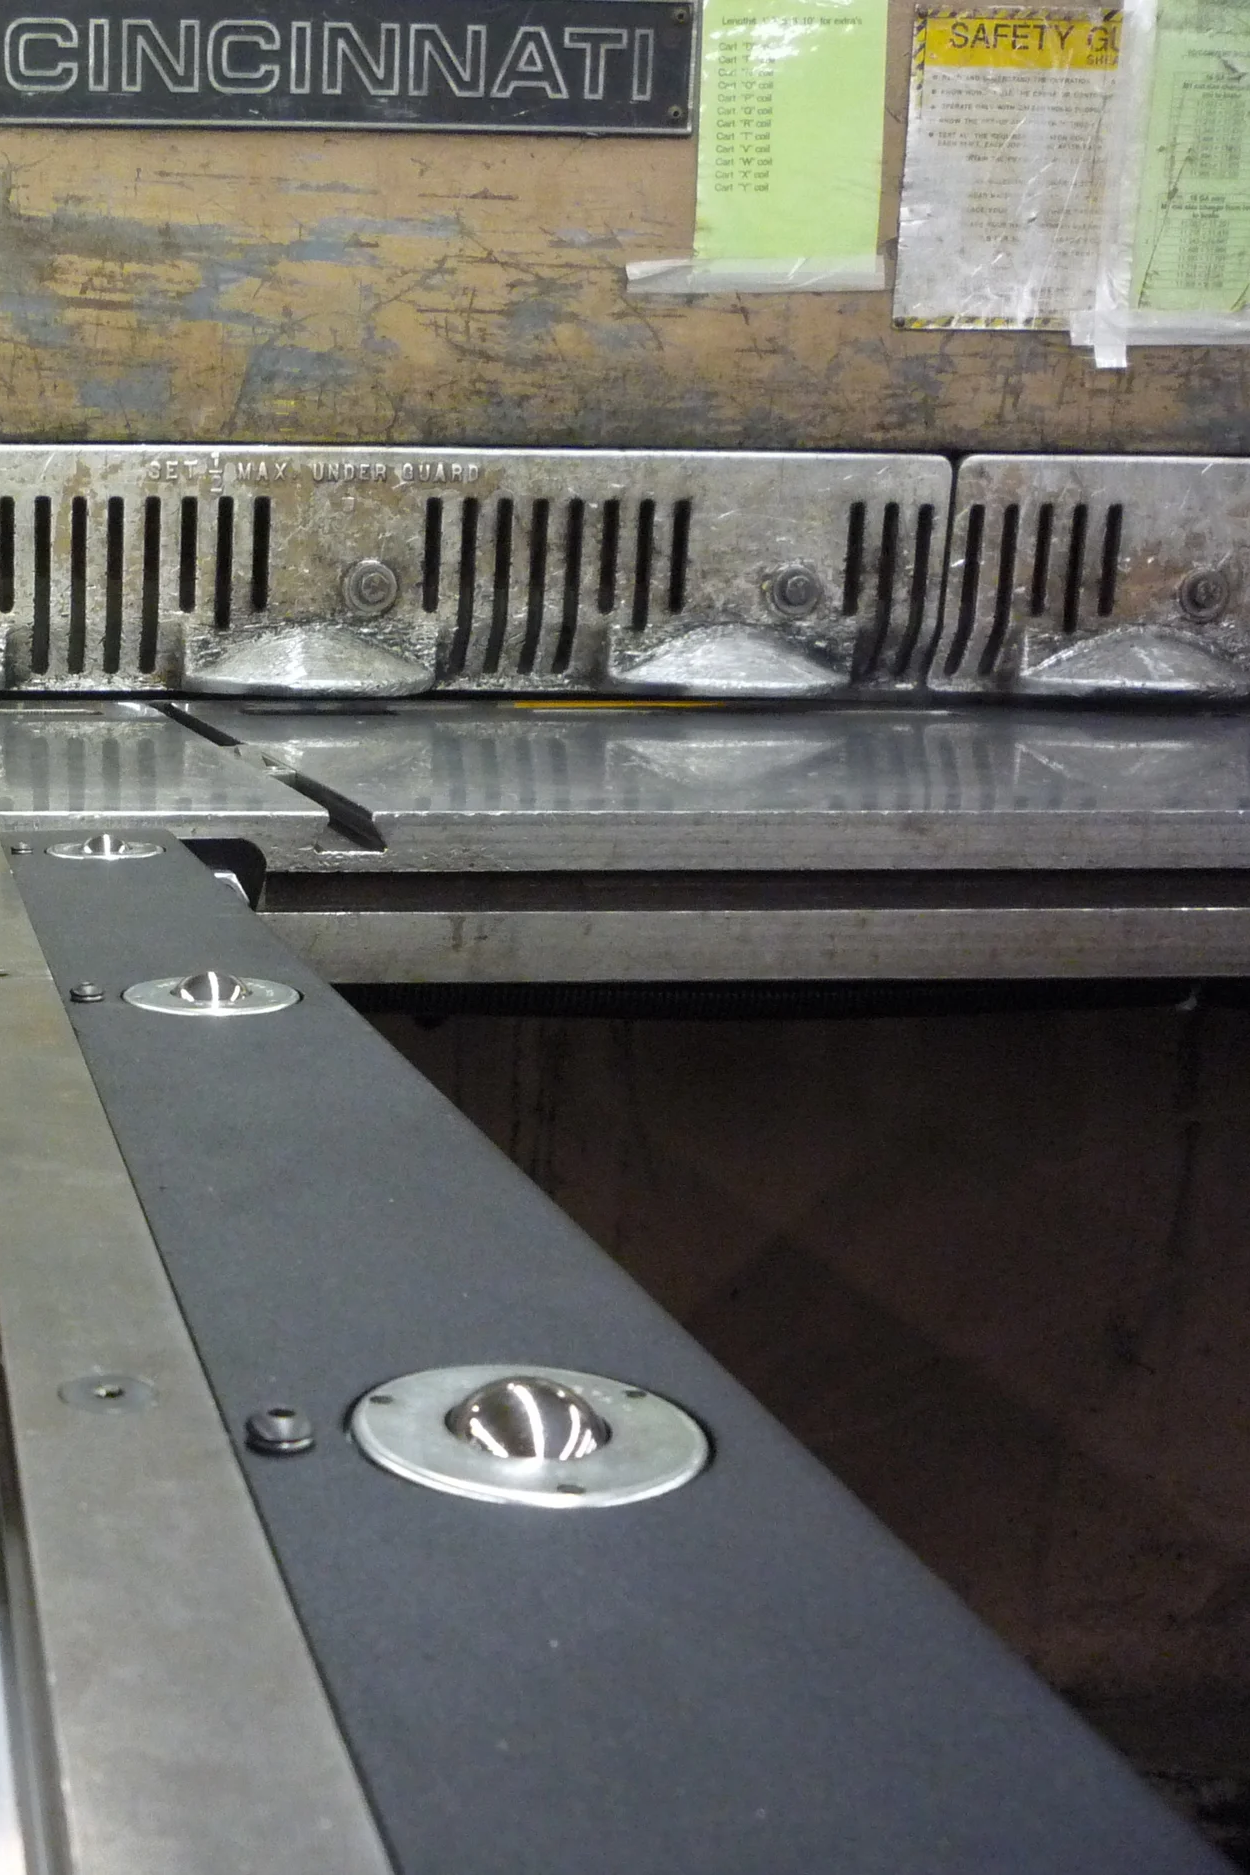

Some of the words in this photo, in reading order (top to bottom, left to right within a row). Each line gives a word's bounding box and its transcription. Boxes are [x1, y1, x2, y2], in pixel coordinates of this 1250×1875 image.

[950, 22, 1075, 50] SAFETY
[4, 17, 654, 101] CINCINNATI
[716, 106, 736, 115] Cart
[716, 119, 735, 128] Cart
[716, 132, 735, 141] Cart
[715, 144, 734, 153] Cart
[715, 157, 734, 166] Cart
[715, 170, 734, 179] Cart
[714, 183, 733, 192] Cart
[148, 459, 198, 481] SET
[312, 462, 388, 483] UNDER
[402, 461, 480, 483] GUARD
